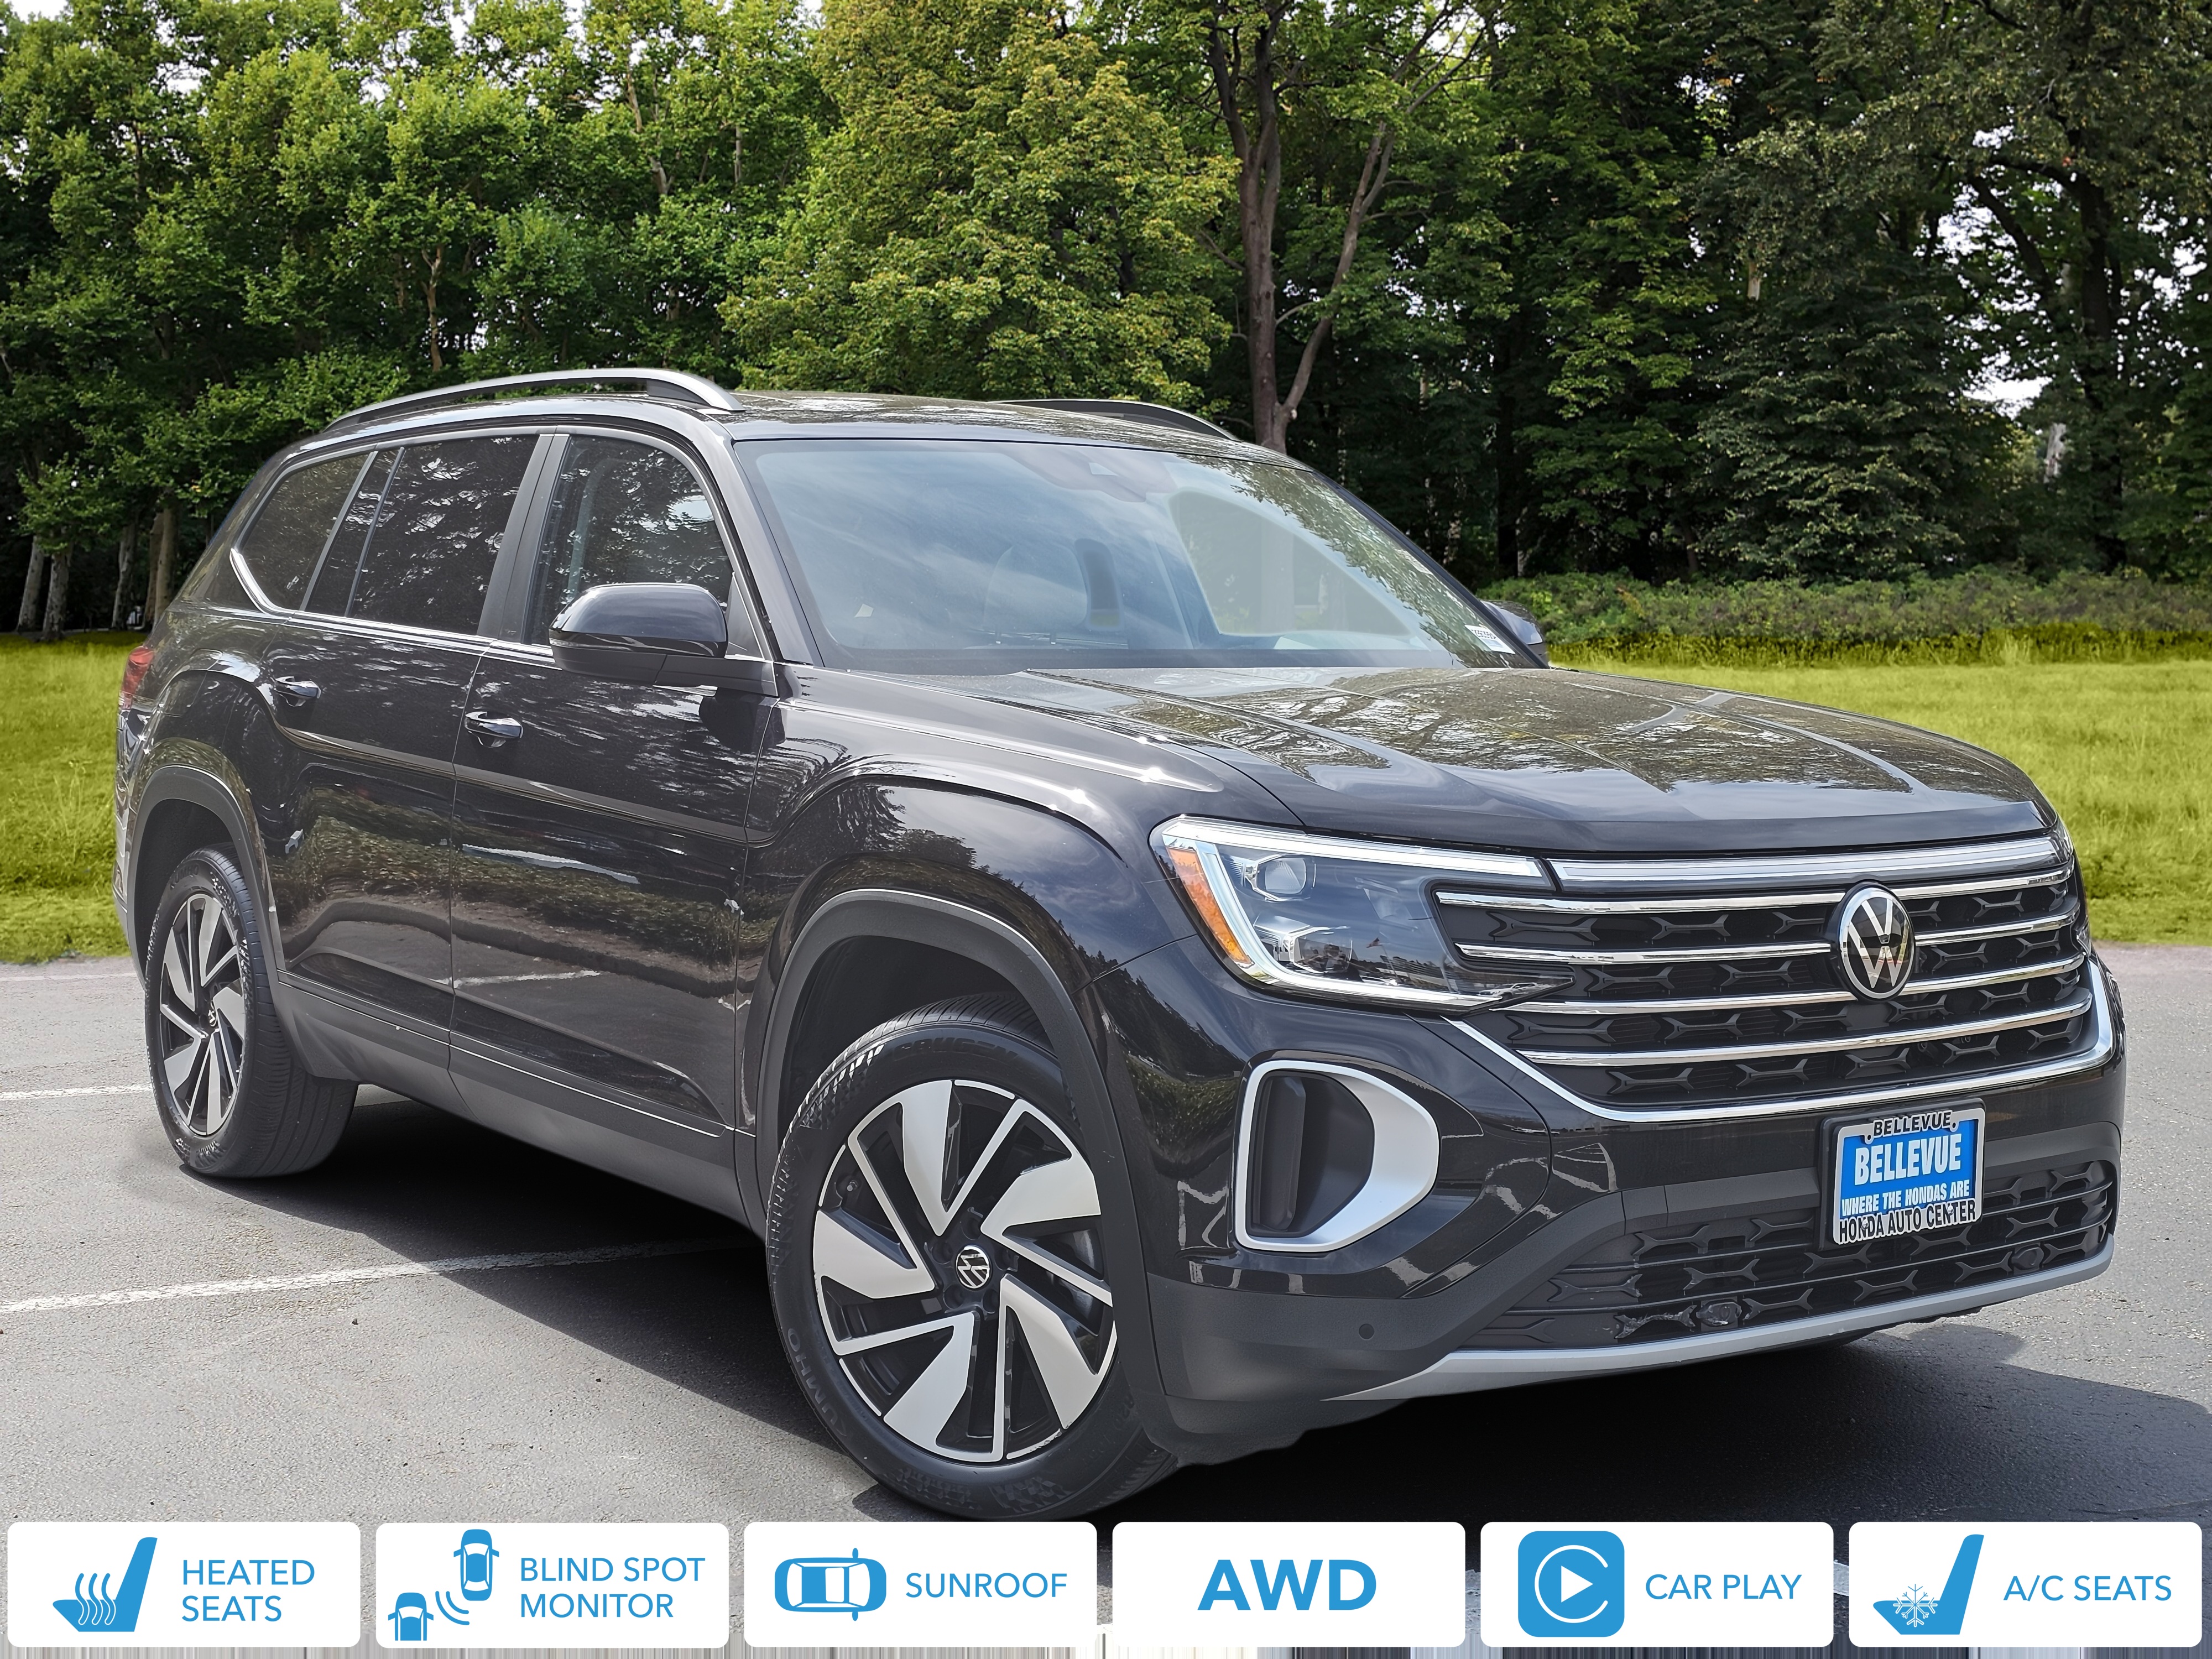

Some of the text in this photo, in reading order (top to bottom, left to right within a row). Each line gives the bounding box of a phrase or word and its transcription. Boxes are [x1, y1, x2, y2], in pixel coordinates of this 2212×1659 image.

[1874, 1112, 1952, 1134] BELLEVUE
[1854, 1133, 1962, 1186] BELLEVUE
[1841, 1179, 1970, 1217] WHERE THE HONDAS ARE
[1839, 1199, 1976, 1243] HONDA AUTO CENTER
